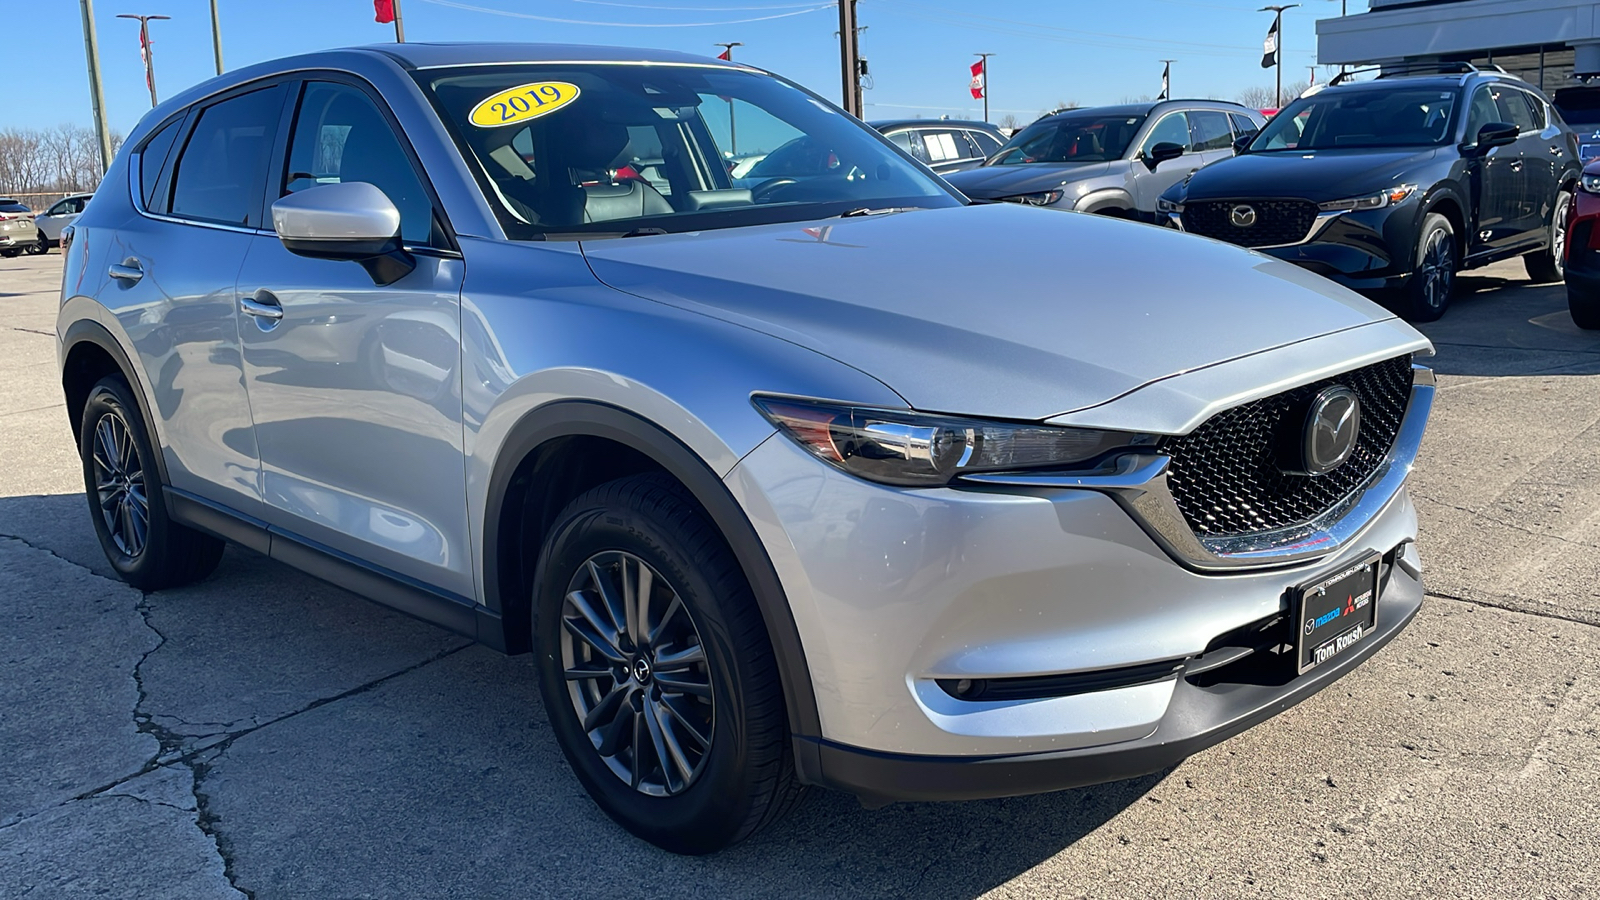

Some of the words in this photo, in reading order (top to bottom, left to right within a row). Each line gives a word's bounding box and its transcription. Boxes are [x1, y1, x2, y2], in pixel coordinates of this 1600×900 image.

[491, 86, 561, 121] 2019
[1315, 607, 1340, 628] mazda
[1315, 643, 1335, 663] Tom
[1336, 625, 1363, 652] Roush
